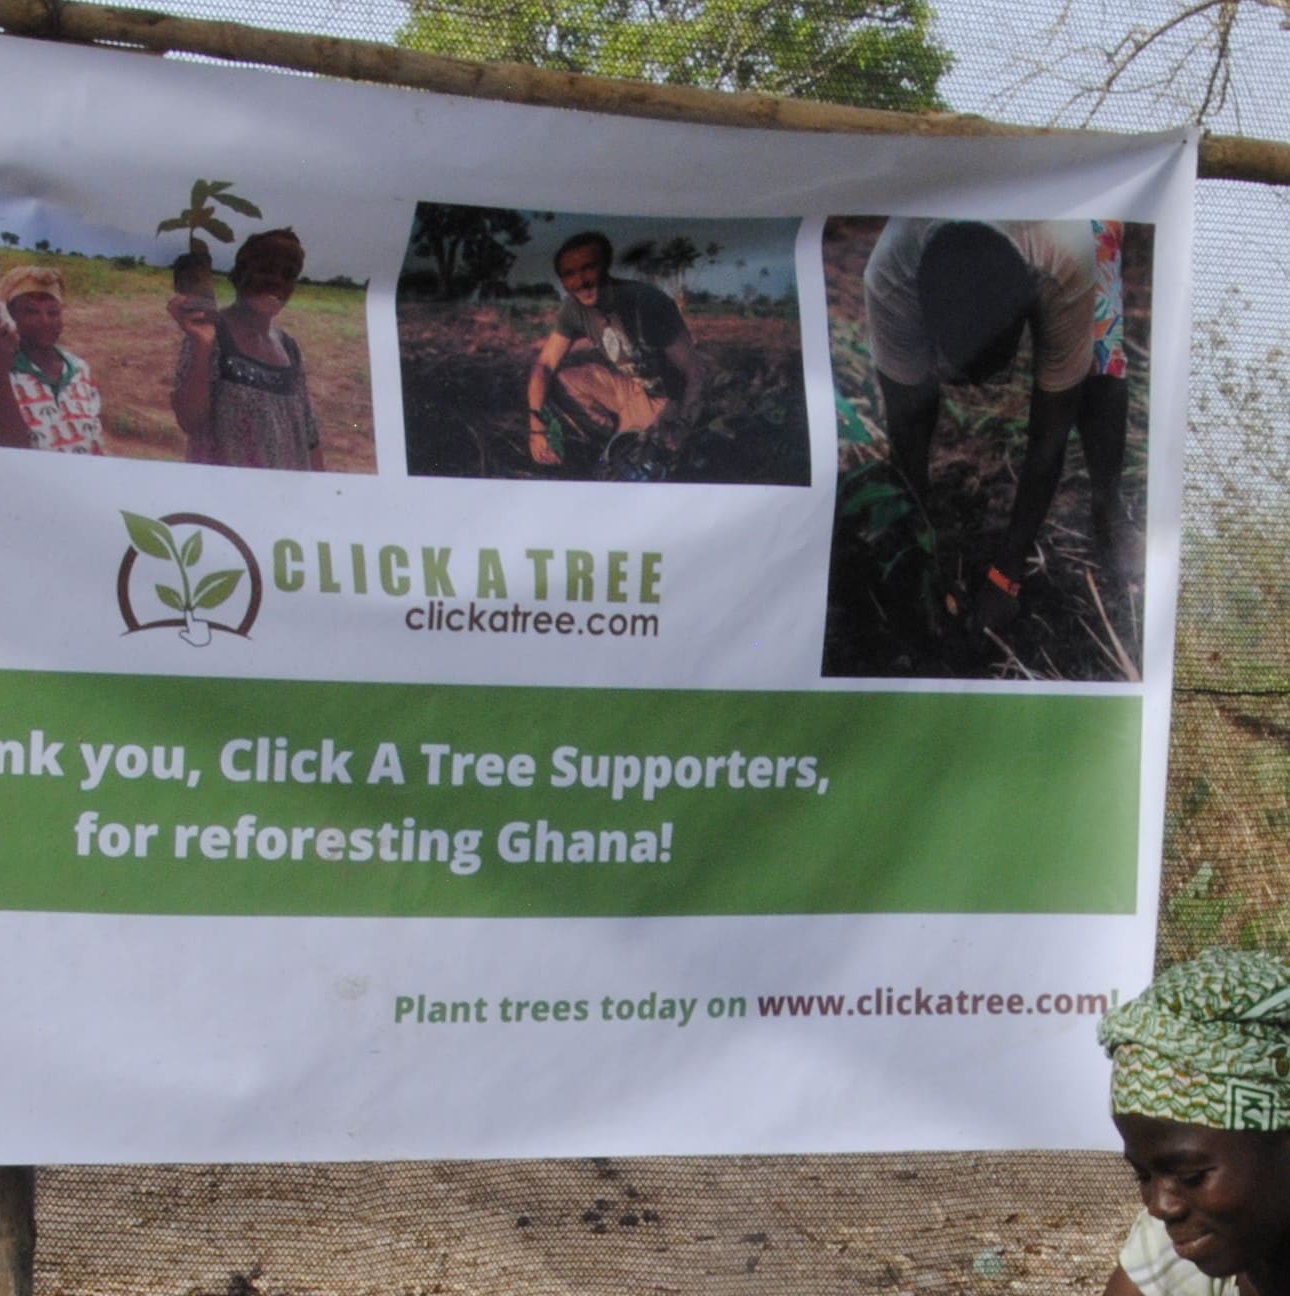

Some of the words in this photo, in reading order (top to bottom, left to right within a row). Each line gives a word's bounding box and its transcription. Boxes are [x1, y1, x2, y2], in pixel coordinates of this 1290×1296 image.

[272, 539, 456, 597] CLICK
[476, 547, 509, 599] A
[525, 548, 663, 603] TREE
[405, 602, 660, 637] clickatree.com
[79, 743, 202, 790] you,
[219, 737, 352, 785] Click
[368, 742, 406, 785] A
[421, 743, 537, 787] Tree
[549, 746, 830, 800] Supporters,
[74, 811, 159, 858] for
[173, 815, 483, 875] reforesting
[497, 820, 674, 864] Ghana!
[394, 994, 489, 1024] Plant
[499, 997, 590, 1022] trees
[600, 992, 698, 1027] today
[707, 997, 747, 1019] on
